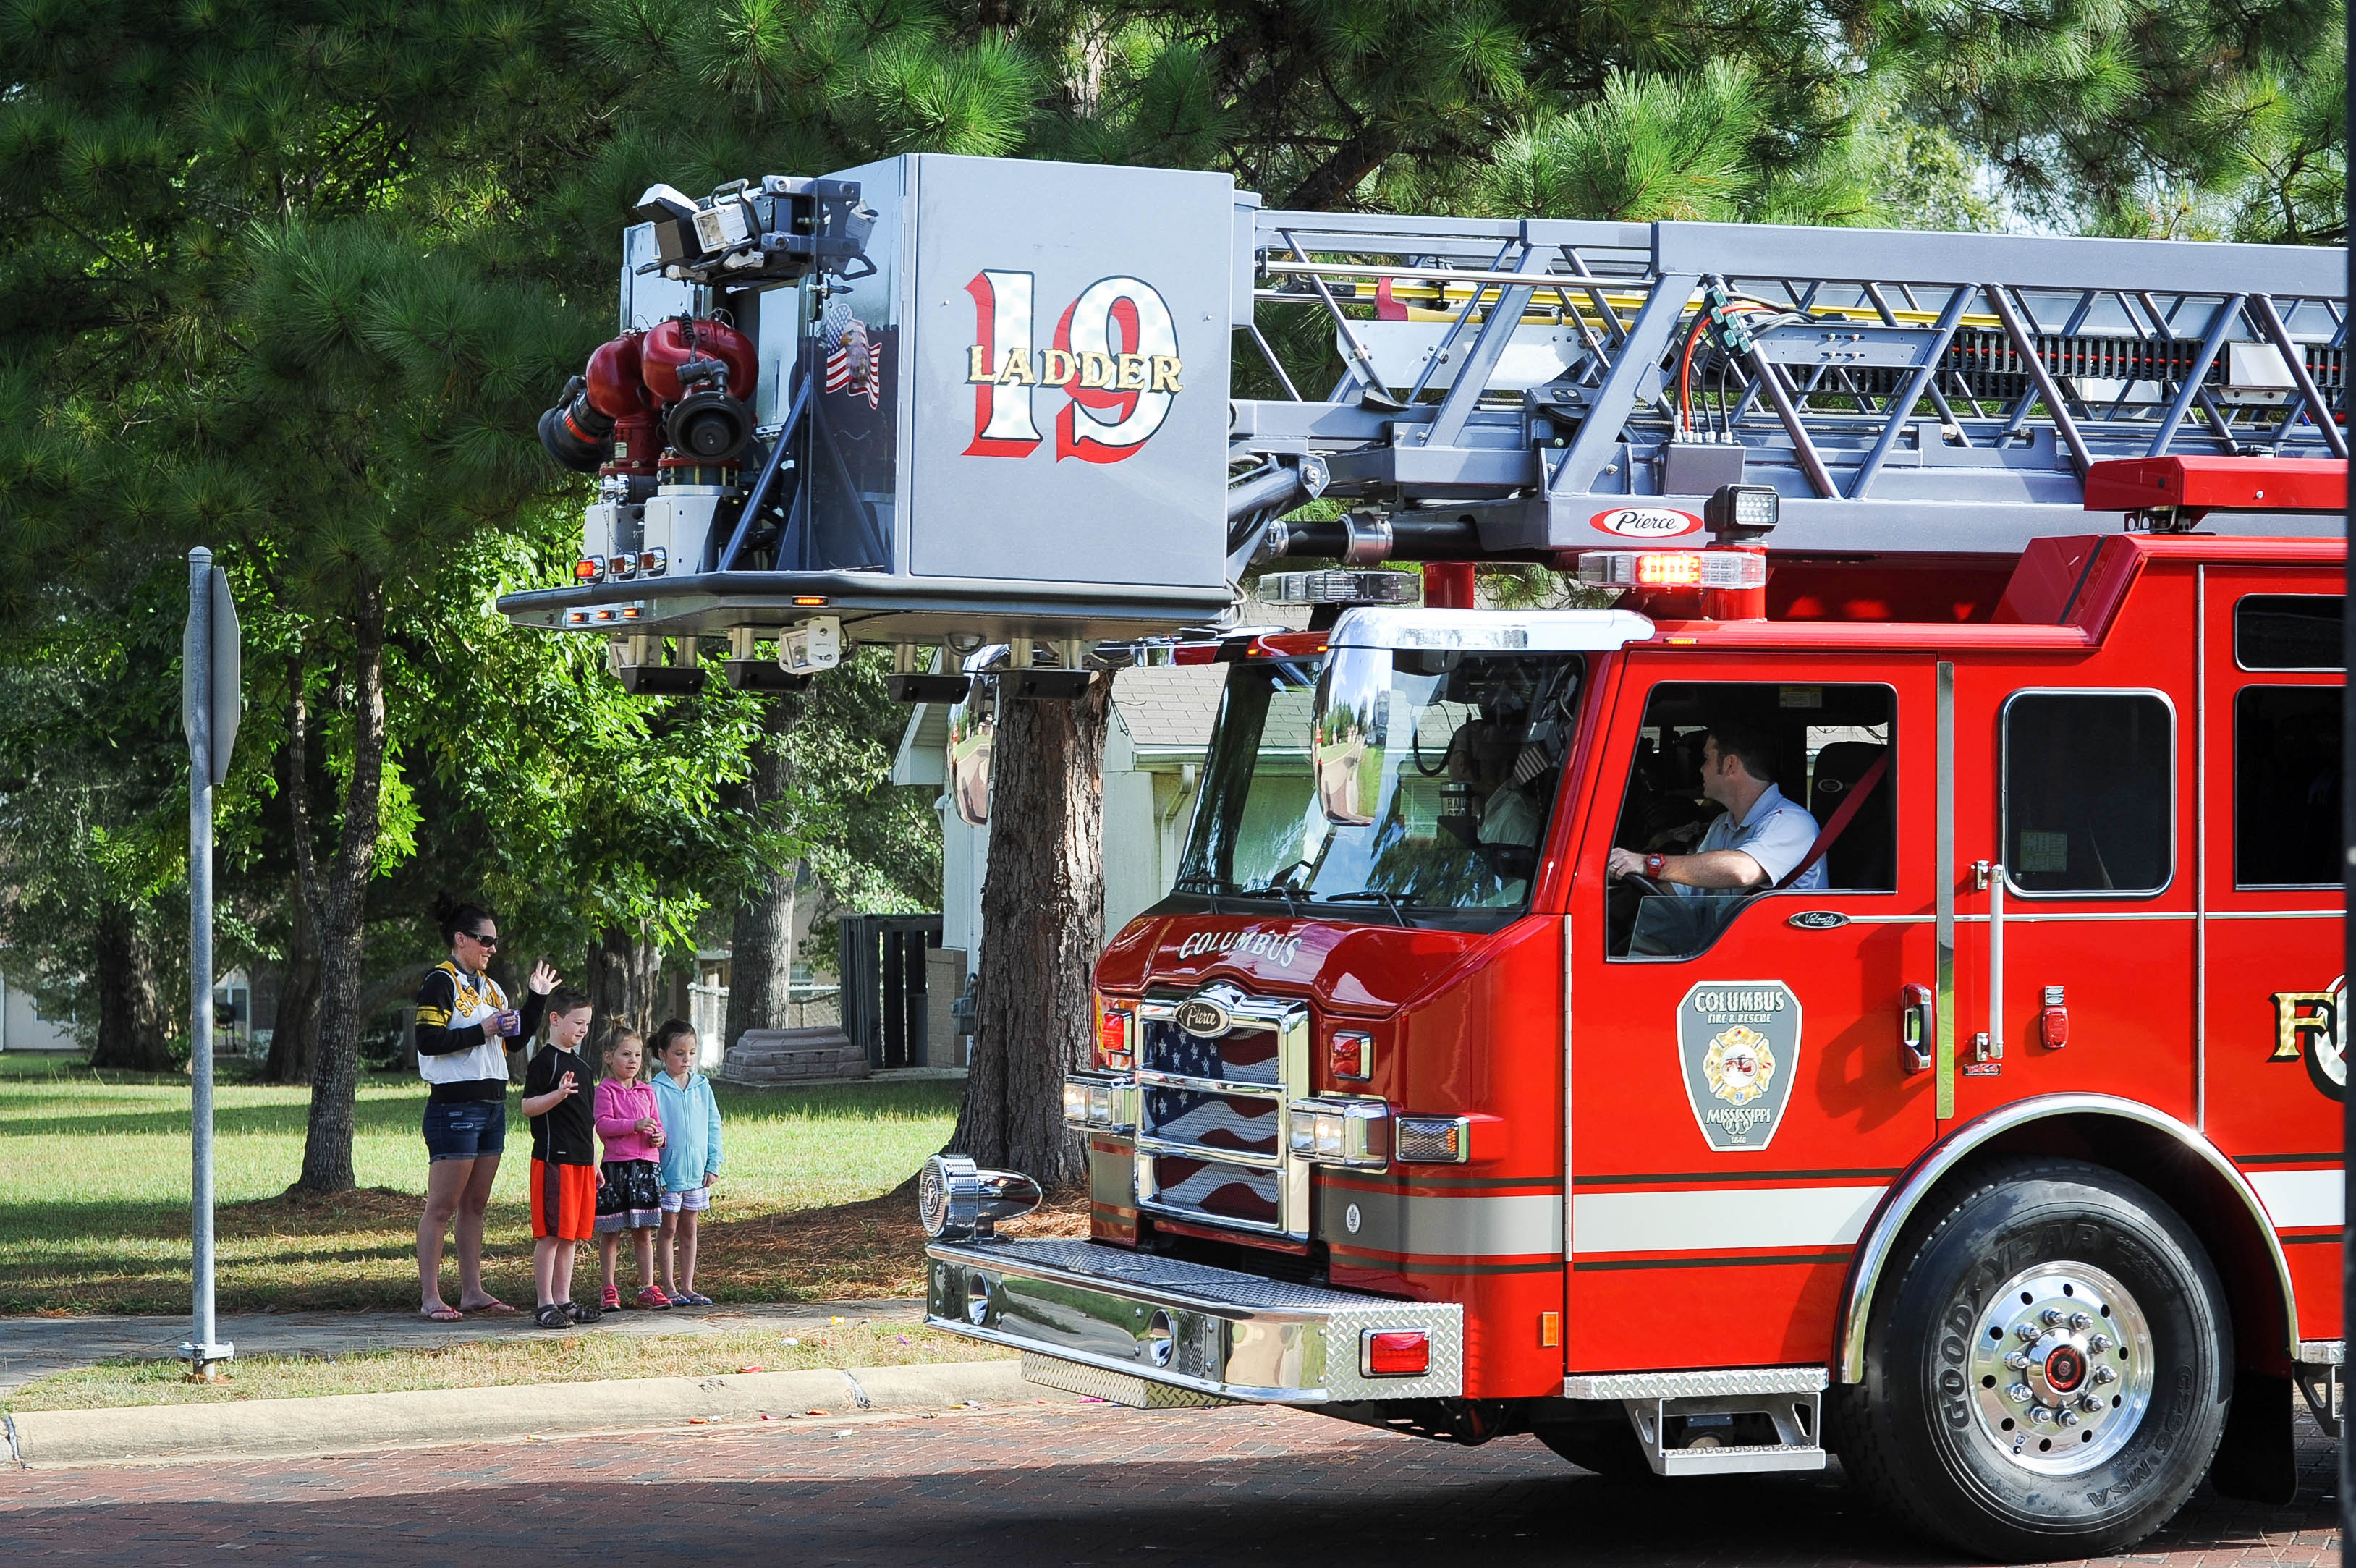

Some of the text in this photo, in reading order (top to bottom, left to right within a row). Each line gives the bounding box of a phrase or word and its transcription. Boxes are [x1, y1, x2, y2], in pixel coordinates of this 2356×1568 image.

[962, 268, 1180, 464] 19
[963, 343, 1184, 397] LADDER
[1616, 511, 1677, 531] Pierce
[1179, 931, 1302, 968] COLUMBUS
[1694, 991, 1785, 1012] COLUMBUS
[1187, 1005, 1216, 1027] Pierce
[1708, 1013, 1772, 1024] FIRE & RESCUE
[1705, 1108, 1771, 1135] MISSISSIPPI
[1939, 1223, 2102, 1431] GOODYEAR
